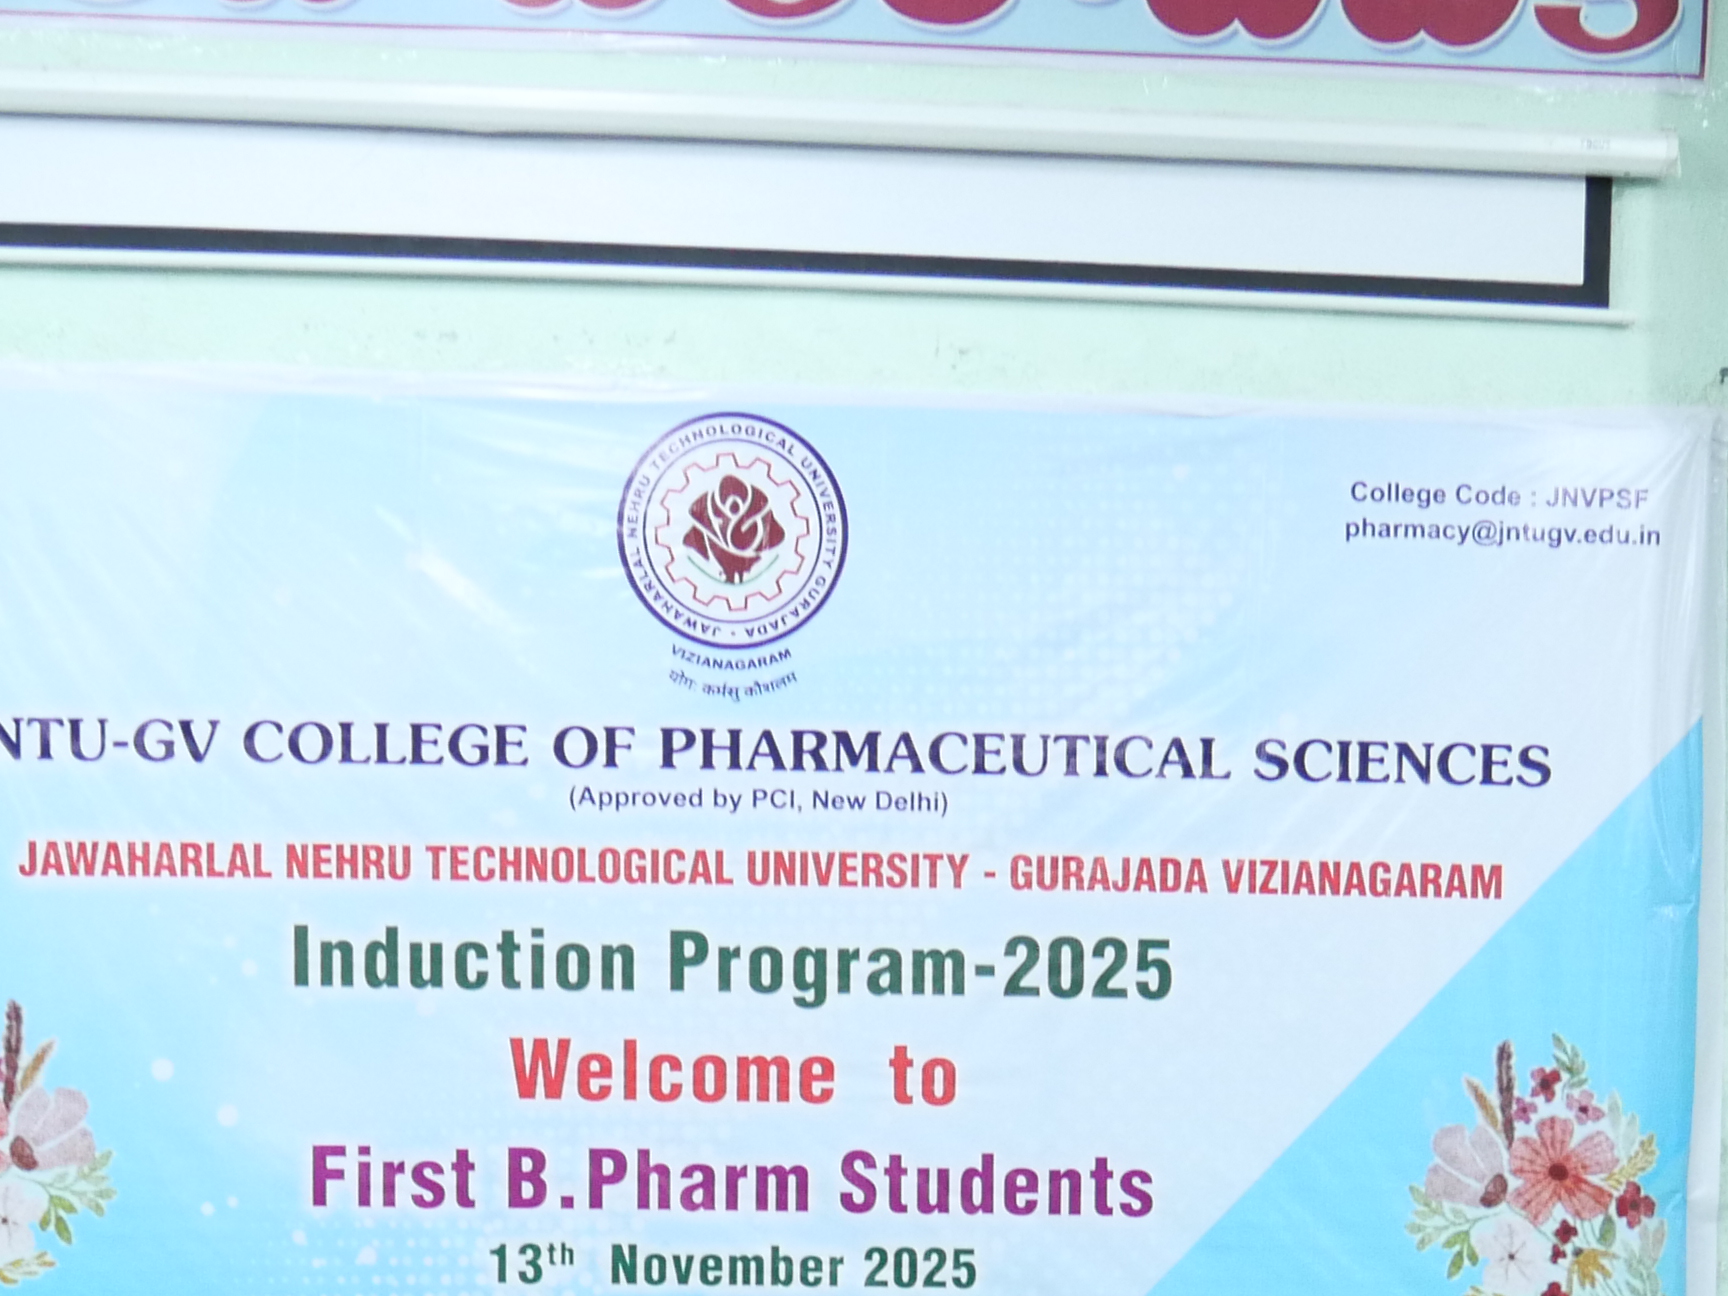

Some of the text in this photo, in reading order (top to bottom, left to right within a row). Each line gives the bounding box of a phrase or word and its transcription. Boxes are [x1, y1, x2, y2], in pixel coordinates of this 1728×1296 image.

[650, 423, 796, 471] TECHNOLOGICAL
[627, 475, 652, 539] NEHRU
[800, 456, 837, 572] UNIVERSITY
[1350, 481, 1446, 509] College
[1455, 483, 1521, 507] Code
[1545, 487, 1649, 510] JNVPSF
[1345, 516, 1661, 549] pharmacy@jntugv.edu.in
[745, 576, 826, 638] GURAJADA
[671, 643, 792, 670] VIZIANAGARAM
[243, 720, 529, 767] COLLEGE
[553, 725, 636, 769] OF
[660, 727, 1232, 780] PHARMACEUTICAL
[1253, 739, 1552, 788] SCIENCES
[569, 786, 948, 818] (Approved by PCI, New Delhi)
[18, 840, 273, 879] JAWAHARLAL
[286, 843, 411, 881] NEHRU
[425, 845, 734, 885] TECHNOLOGICAL
[747, 850, 970, 889] UNIVERSITY
[1010, 854, 1209, 894] GURAJADA
[1222, 859, 1503, 900] VIZIANAGARAM
[293, 924, 1172, 1010] Induction Program-2025
[509, 1037, 957, 1107] Welcome to
[312, 1145, 1153, 1218] First B.Pharm Students
[489, 1242, 977, 1289] 13th November 2025
